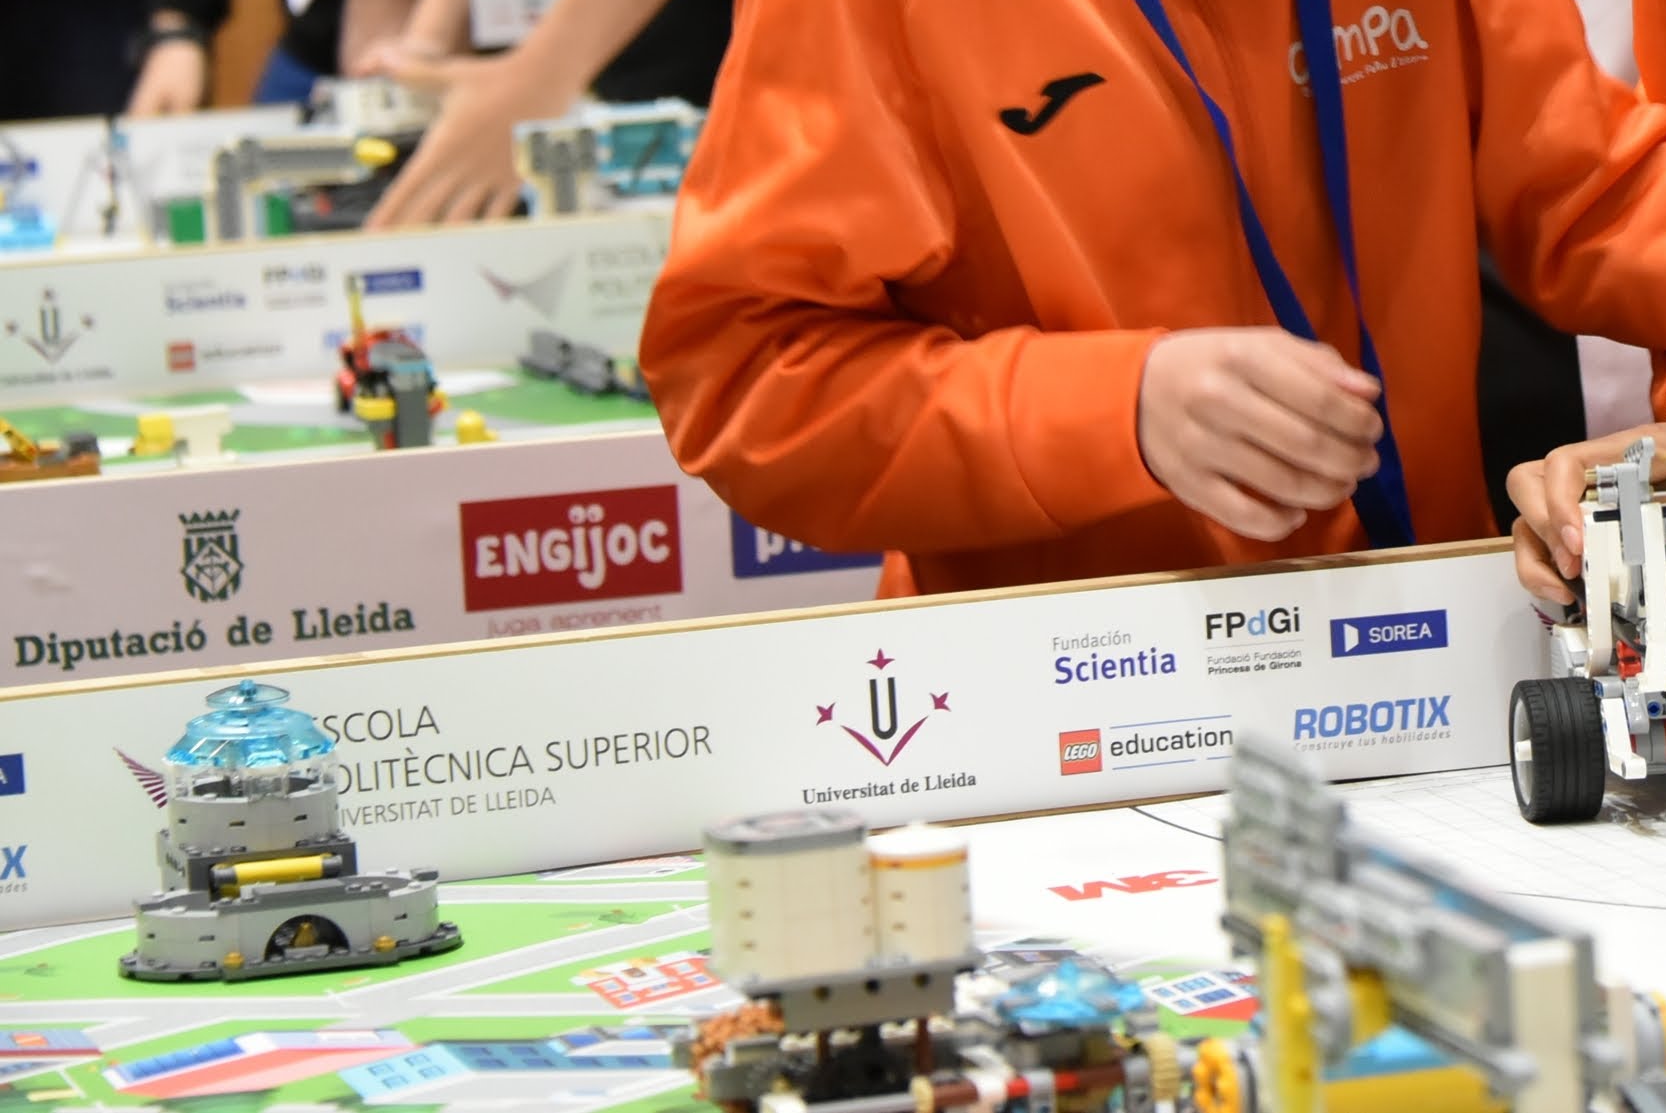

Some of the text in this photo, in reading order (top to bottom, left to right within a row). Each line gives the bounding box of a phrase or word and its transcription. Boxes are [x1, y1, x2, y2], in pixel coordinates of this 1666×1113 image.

[15, 605, 415, 670] Diputació de Lleida
[1205, 607, 1301, 640] FPdGi
[1368, 622, 1433, 644] SOREA
[1053, 631, 1132, 651] Fundación
[1054, 647, 1177, 685] Scientia
[1254, 663, 1266, 672] de
[1269, 660, 1303, 670] Girona
[312, 705, 440, 745] SCOLA
[1293, 695, 1452, 741] ROBOTIX
[1063, 742, 1100, 762] LEGO
[1110, 726, 1233, 758] education
[1358, 736, 1377, 747] tus
[1381, 730, 1452, 745] habilidades
[337, 725, 712, 795] OLITÈCNICA SUPERIOR
[802, 772, 977, 805] Universitat de Lleida
[341, 785, 557, 828] IVERSITAT DE LLEIDA
[1048, 870, 1219, 901] 3M
